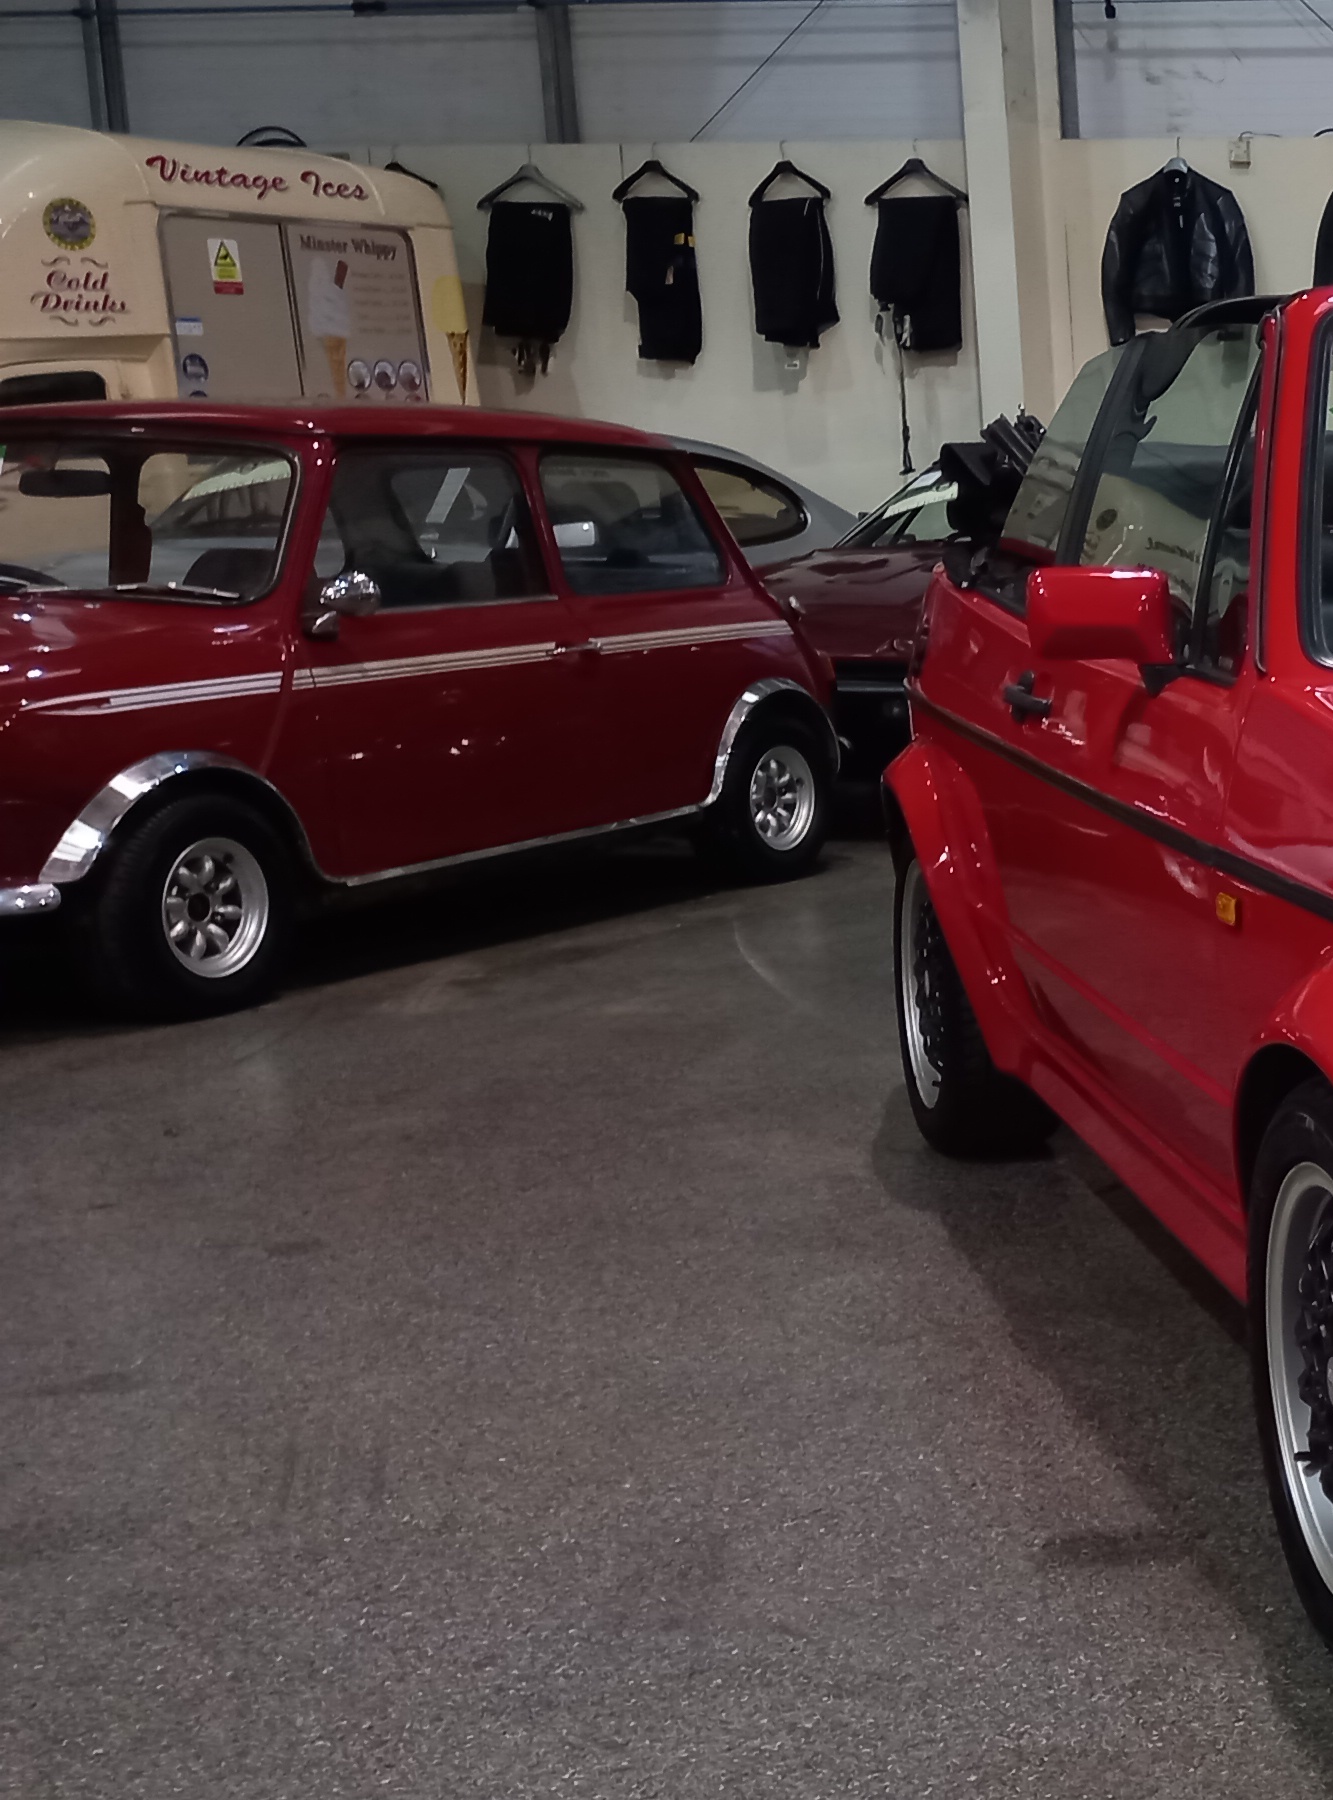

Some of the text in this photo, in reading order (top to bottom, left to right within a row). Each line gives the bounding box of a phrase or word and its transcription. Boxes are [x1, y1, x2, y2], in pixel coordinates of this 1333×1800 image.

[145, 154, 369, 201] Vintage Ices
[350, 238, 397, 261] Whippy
[46, 269, 111, 292] Cold
[30, 291, 131, 314] Drinks
